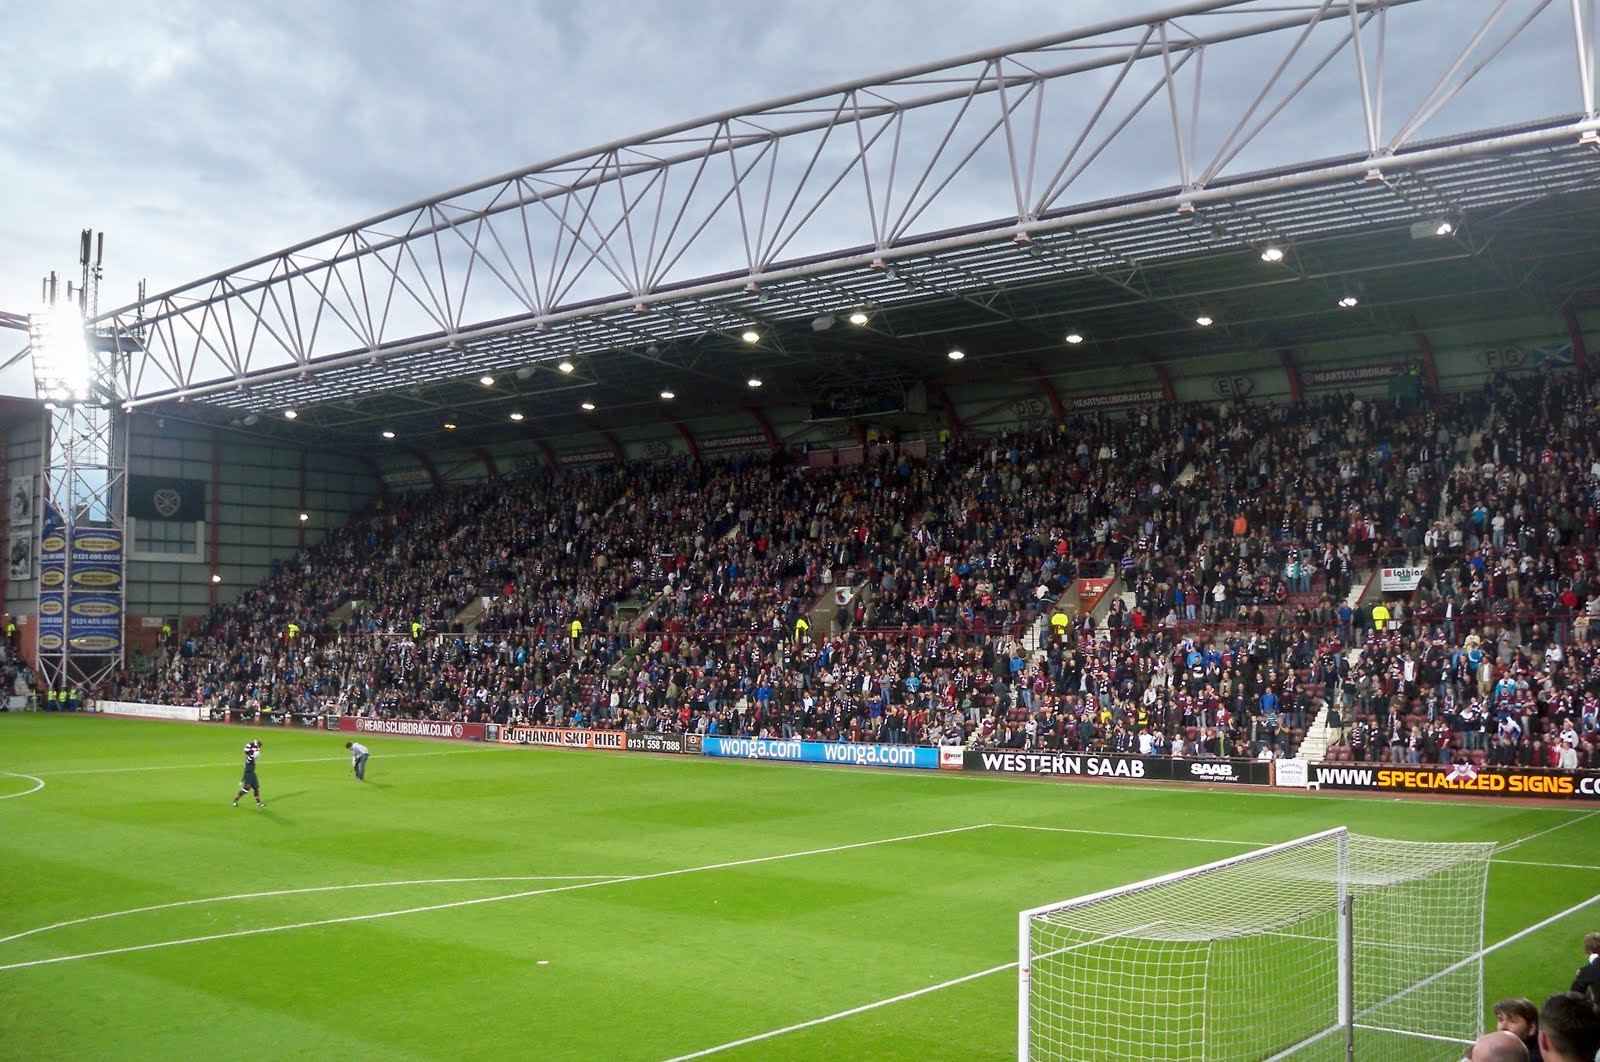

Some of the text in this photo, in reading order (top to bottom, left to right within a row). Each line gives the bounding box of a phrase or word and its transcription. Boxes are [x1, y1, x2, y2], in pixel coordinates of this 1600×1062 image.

[1218, 380, 1228, 394] E
[1030, 401, 1041, 413] E
[1073, 391, 1165, 407] HEARTSCLUBDRAW.CO.UK
[364, 720, 453, 737] HEARTSCLUBDRAW.CO.UK
[502, 729, 562, 744] BUCHANAN
[564, 732, 593, 746] SKIP
[594, 733, 622, 747] HIRE
[627, 738, 645, 749] 0131
[646, 740, 660, 750] 558
[661, 741, 681, 751] 7888
[719, 738, 802, 759] wonga.com
[824, 744, 916, 765] wonga.com
[981, 753, 1146, 778] WESTERN SAAB
[1190, 763, 1233, 776] SAAB
